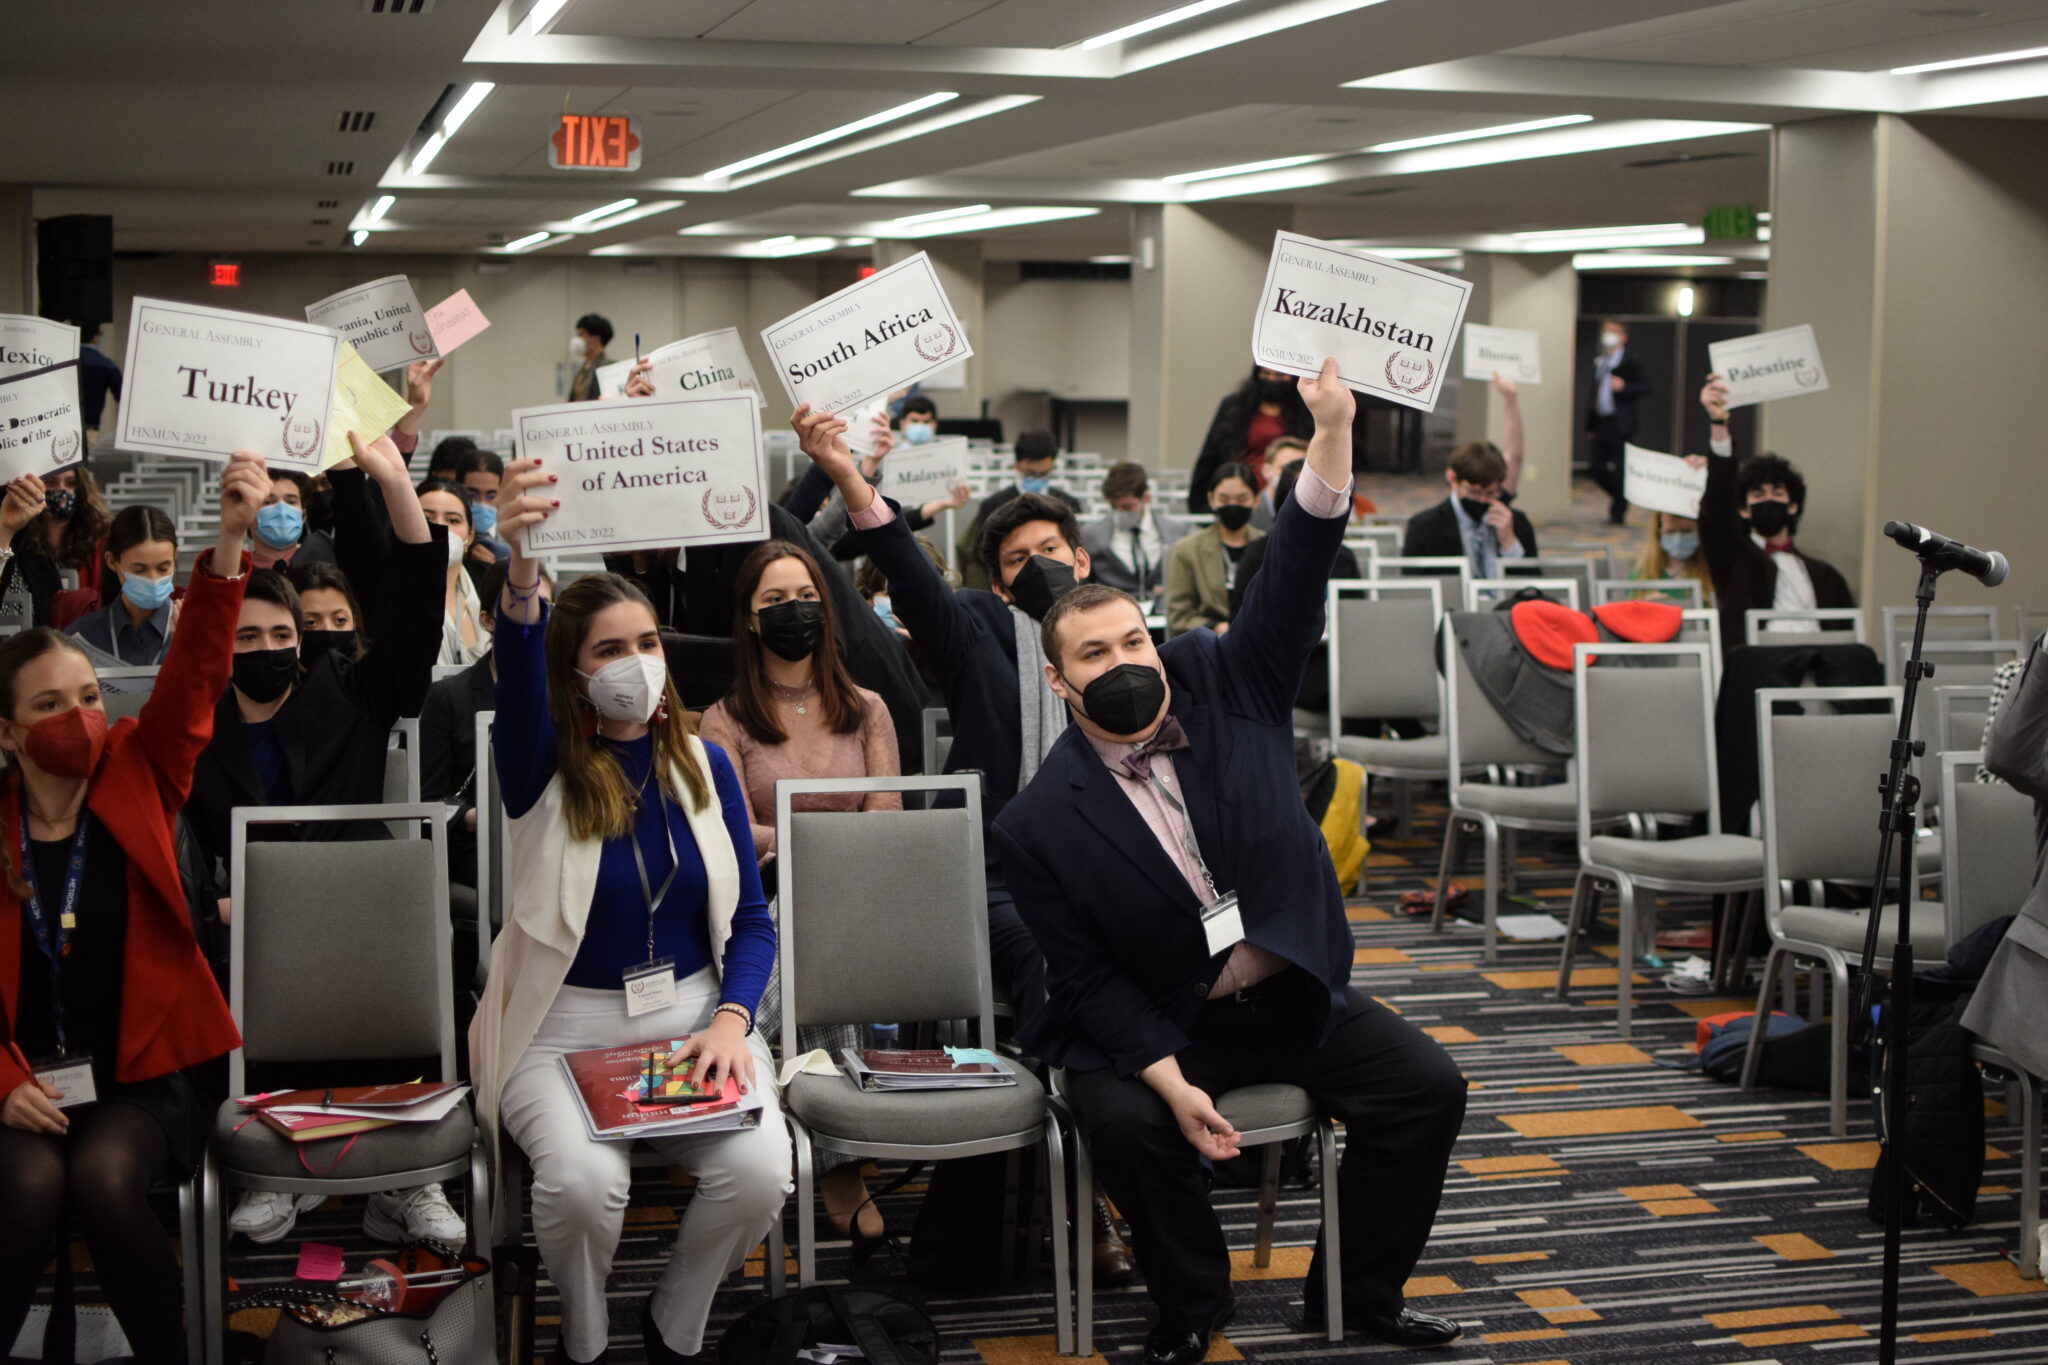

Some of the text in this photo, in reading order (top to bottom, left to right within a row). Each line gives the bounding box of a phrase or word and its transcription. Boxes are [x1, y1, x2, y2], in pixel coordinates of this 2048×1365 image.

[1281, 252, 1379, 285] GENERAL ASSEMBLY
[374, 303, 411, 321] United
[1273, 288, 1433, 352] Kazakhstan
[143, 321, 264, 349] GENERAL ASSEMBLY
[349, 321, 404, 349] public of
[774, 302, 862, 350] GENERAL ASSEMBLY
[788, 307, 934, 385] South Africa
[1262, 346, 1314, 365] HNMUN 2022
[680, 365, 735, 391] China
[1727, 357, 1806, 382] Palestine
[177, 365, 298, 421] Turkey
[843, 388, 863, 404] 2022
[9, 402, 72, 430] Democratic
[21, 431, 33, 446] of
[36, 428, 52, 441] the
[132, 426, 208, 445] HNMUN 2022
[526, 420, 655, 442] GENERAL ASSEMBLY
[565, 436, 719, 462] United States
[582, 466, 708, 492] of America
[897, 464, 958, 484] Malaysia
[535, 528, 615, 543] HNMUN 2022
[64, 878, 76, 913] METROMU
